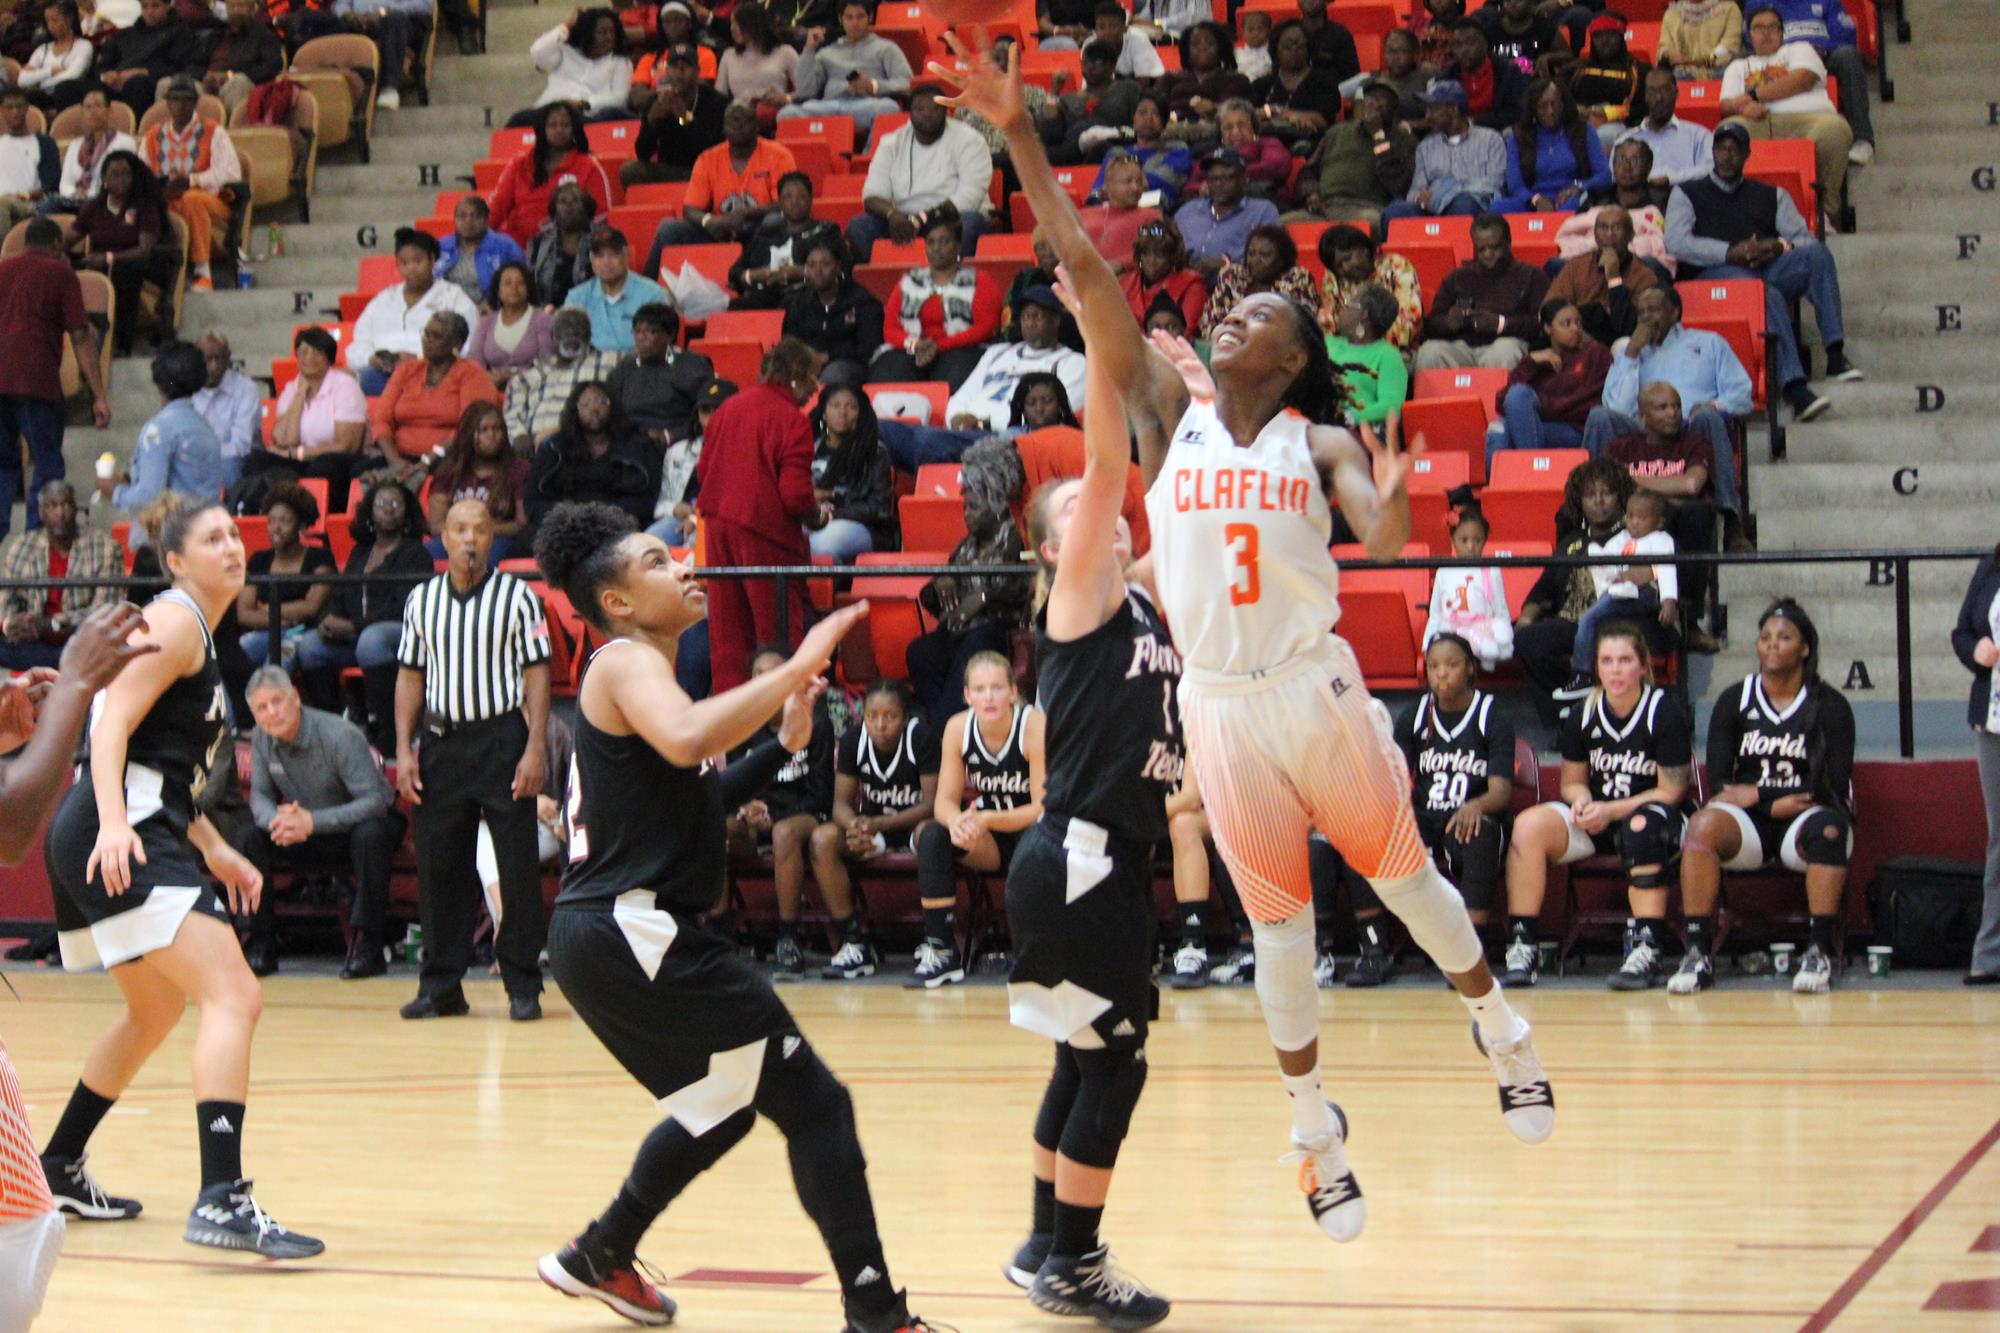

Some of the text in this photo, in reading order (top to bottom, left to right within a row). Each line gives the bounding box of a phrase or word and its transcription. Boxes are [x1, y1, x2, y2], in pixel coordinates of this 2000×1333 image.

[418, 164, 441, 186] H
[1971, 166, 1995, 191] G
[357, 225, 378, 248] G
[1956, 234, 1981, 261] F
[292, 292, 313, 315] F
[1935, 305, 1961, 332] E
[1915, 386, 1945, 413] D
[1175, 467, 1310, 517] CLAFLIN
[1892, 468, 1918, 495] C
[1225, 522, 1261, 606] 3
[1865, 560, 1896, 587] B
[1841, 659, 1875, 690] A
[1739, 729, 1807, 760] Florid
[1428, 771, 1469, 802] 20
